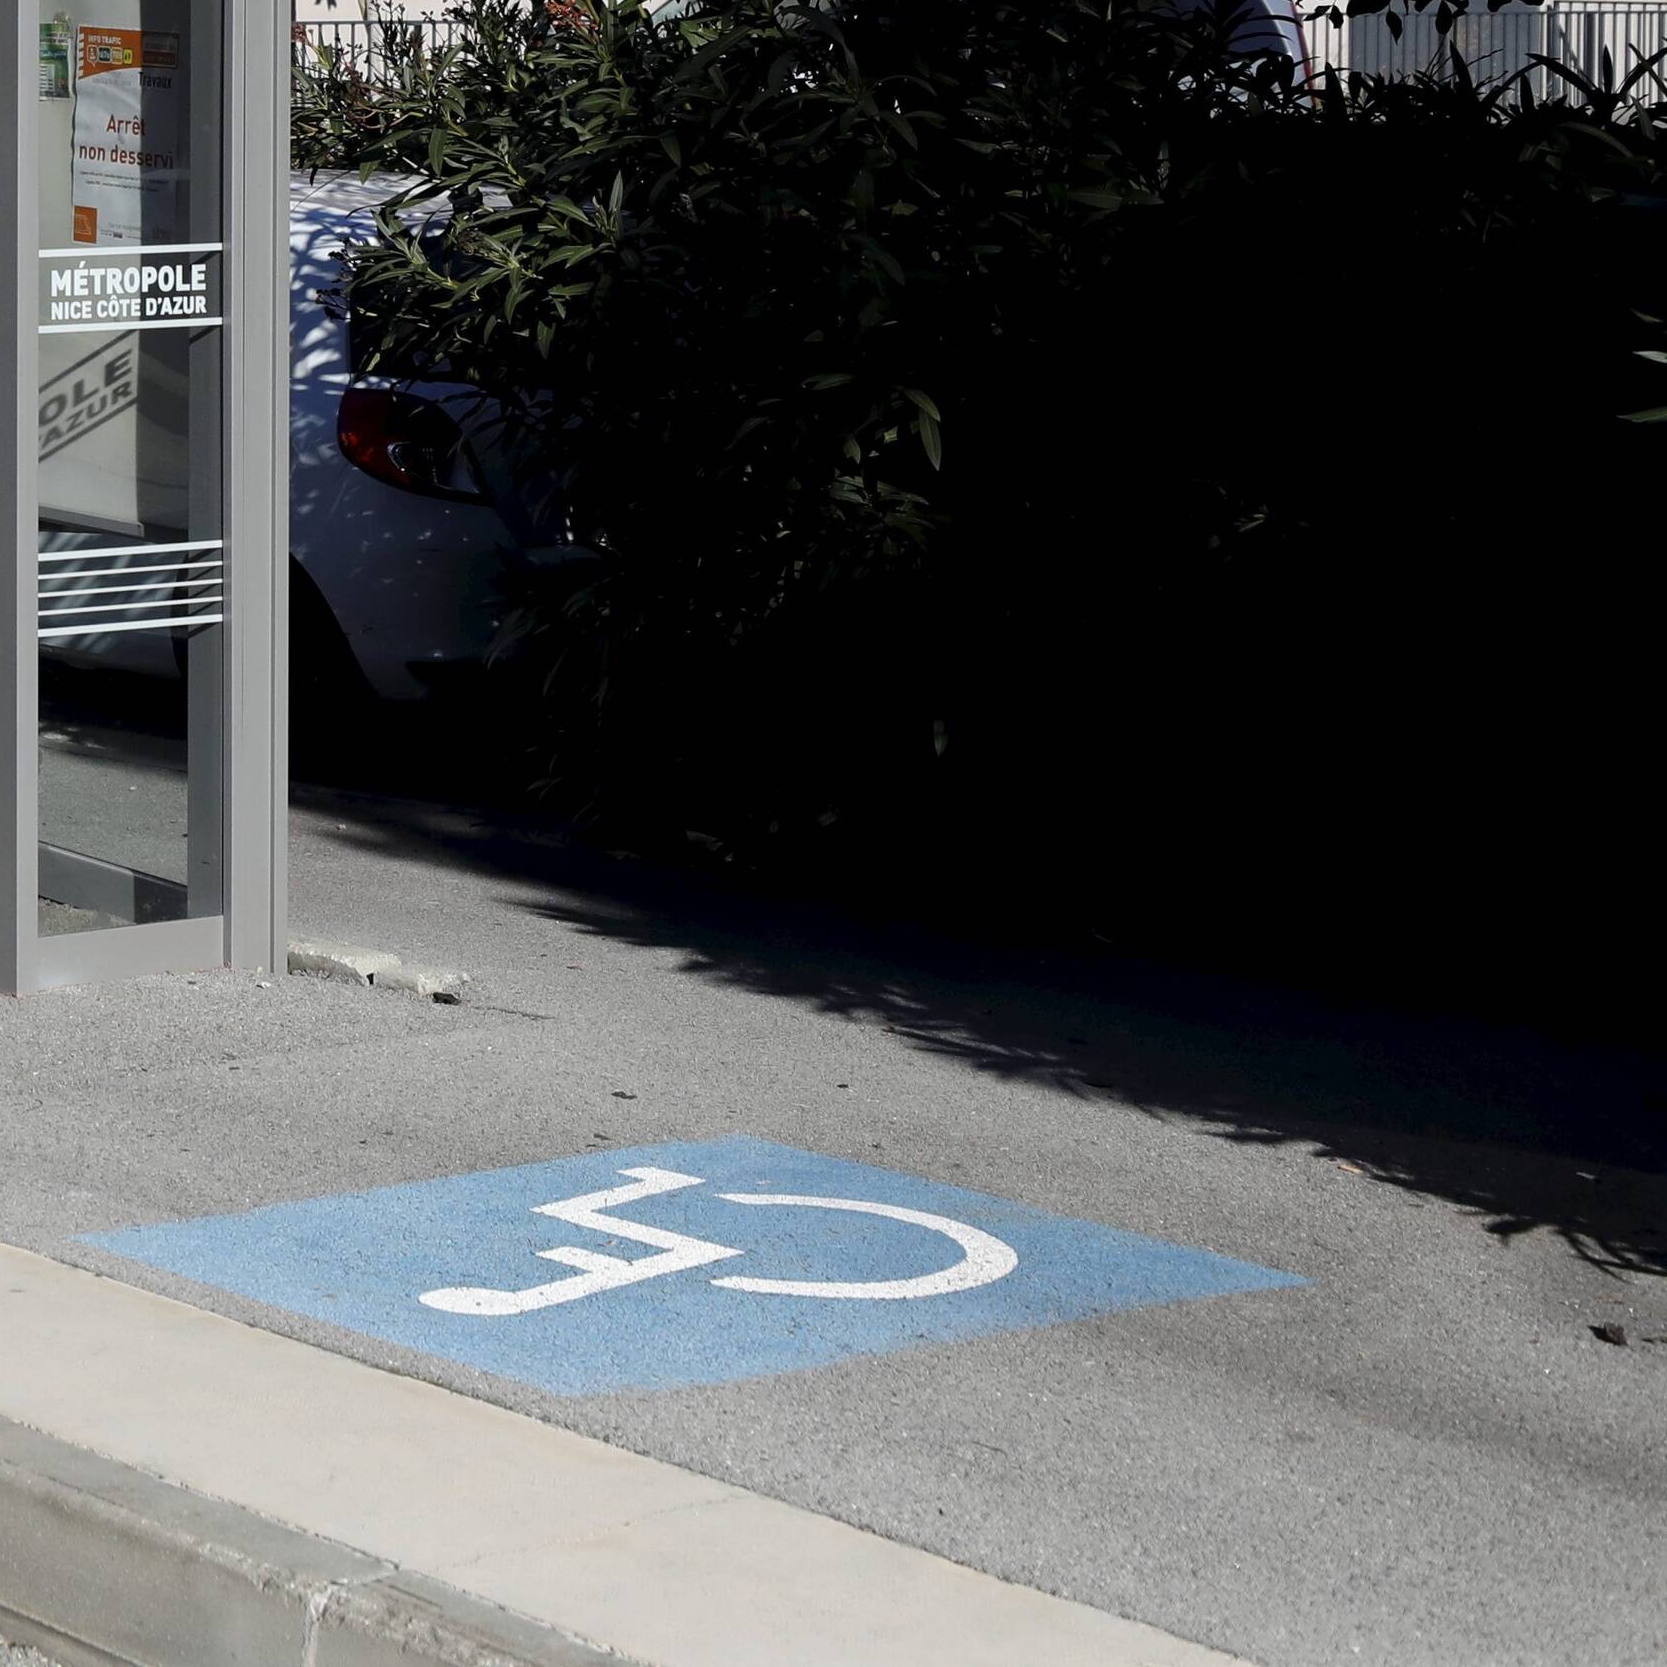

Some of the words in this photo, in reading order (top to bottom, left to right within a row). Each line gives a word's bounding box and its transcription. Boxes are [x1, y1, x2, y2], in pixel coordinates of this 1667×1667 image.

[88, 35, 101, 43] INFO
[139, 70, 172, 88] Travaux
[107, 114, 147, 136] Arrêt
[79, 144, 106, 161] non
[110, 144, 174, 169] desservi
[50, 260, 207, 297] MÉTROPOLE
[51, 301, 92, 320] NICE
[97, 295, 141, 318] CÔTE
[145, 295, 207, 317] D'AZUR
